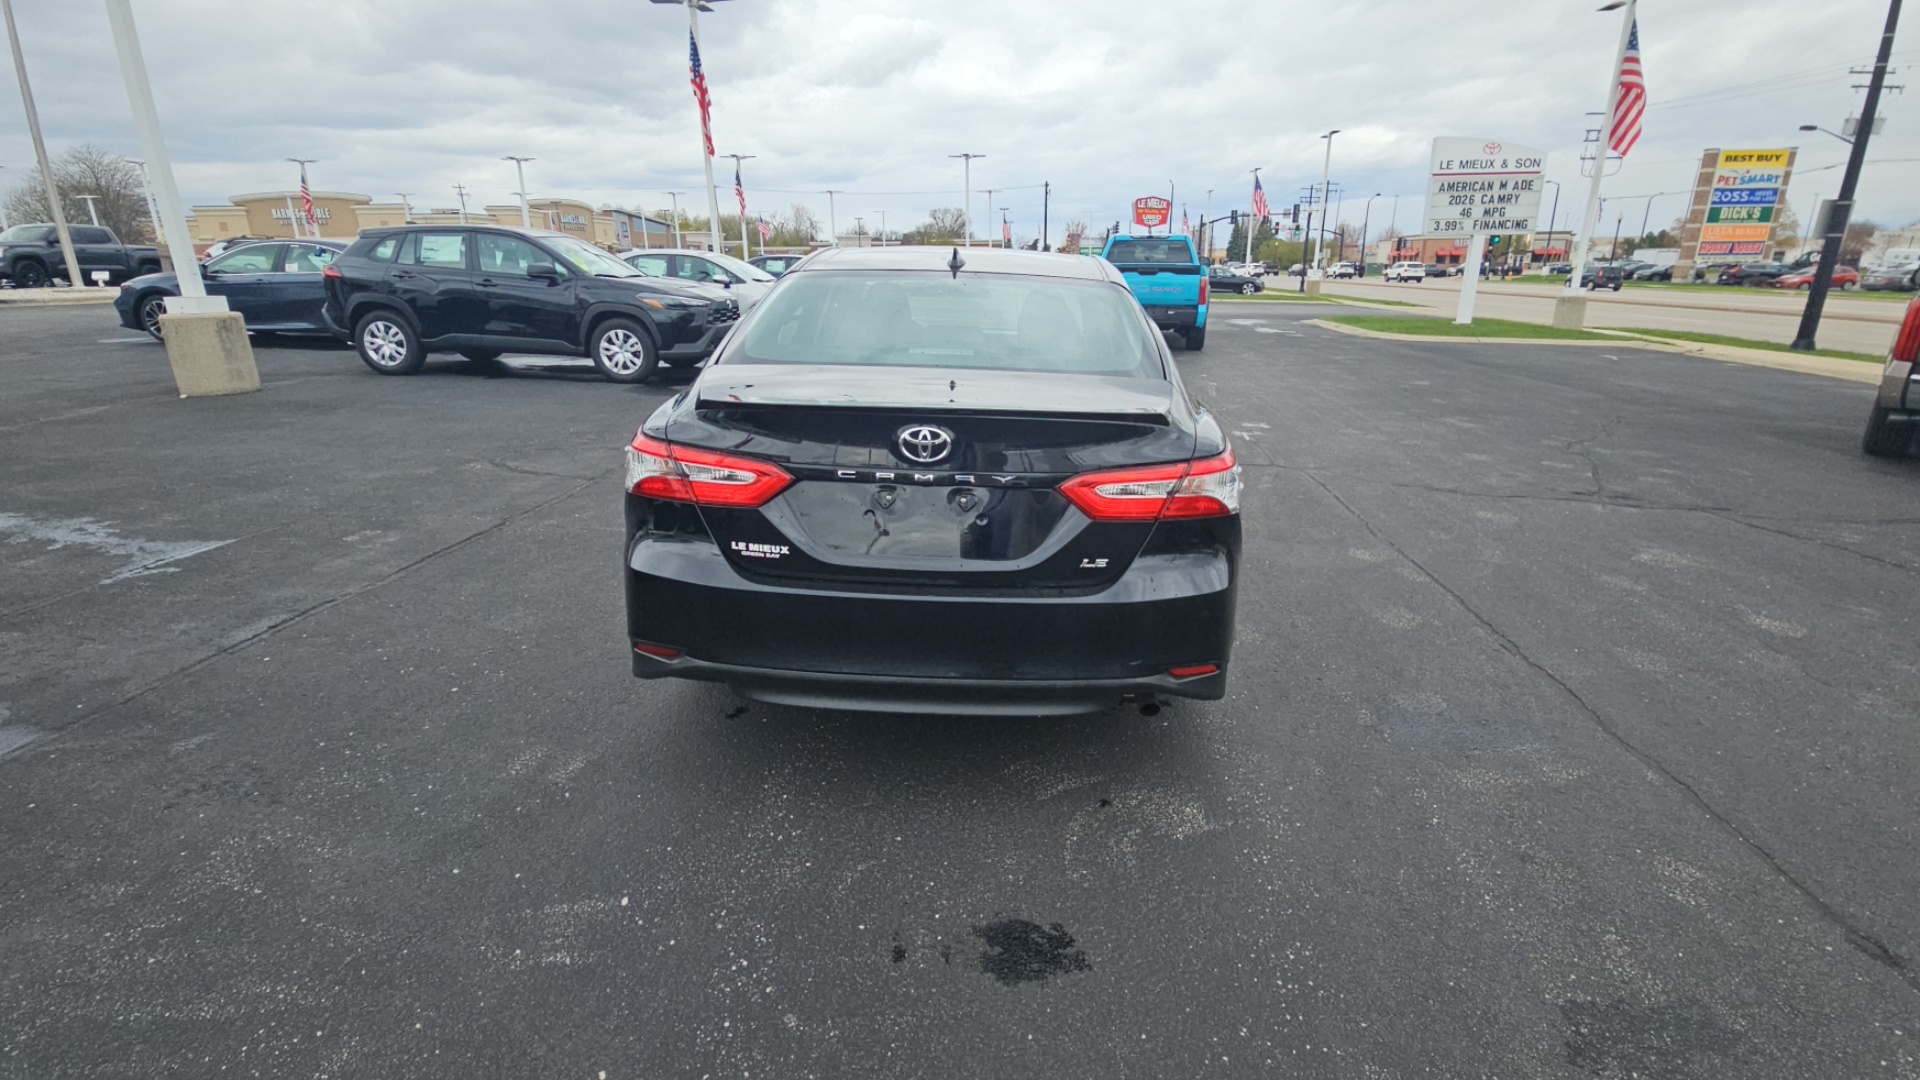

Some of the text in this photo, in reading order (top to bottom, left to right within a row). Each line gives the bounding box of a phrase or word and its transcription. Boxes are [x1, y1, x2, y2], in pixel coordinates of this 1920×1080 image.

[1439, 158, 1541, 170] LE MIEUX & SON
[1756, 154, 1782, 162] BUY
[1438, 181, 1494, 193] AMERICAN
[1448, 193, 1521, 206] 2026 CAMRY
[1712, 190, 1750, 202] ROSS
[1137, 200, 1146, 209] LE
[1459, 206, 1506, 218] 46 MPG
[1720, 207, 1761, 219] DICK'S
[1434, 219, 1528, 231] 3.99% FINANCING
[837, 470, 1016, 484] CAMRY
[731, 541, 790, 555] LE MIEUX
[1080, 558, 1109, 568] LE
